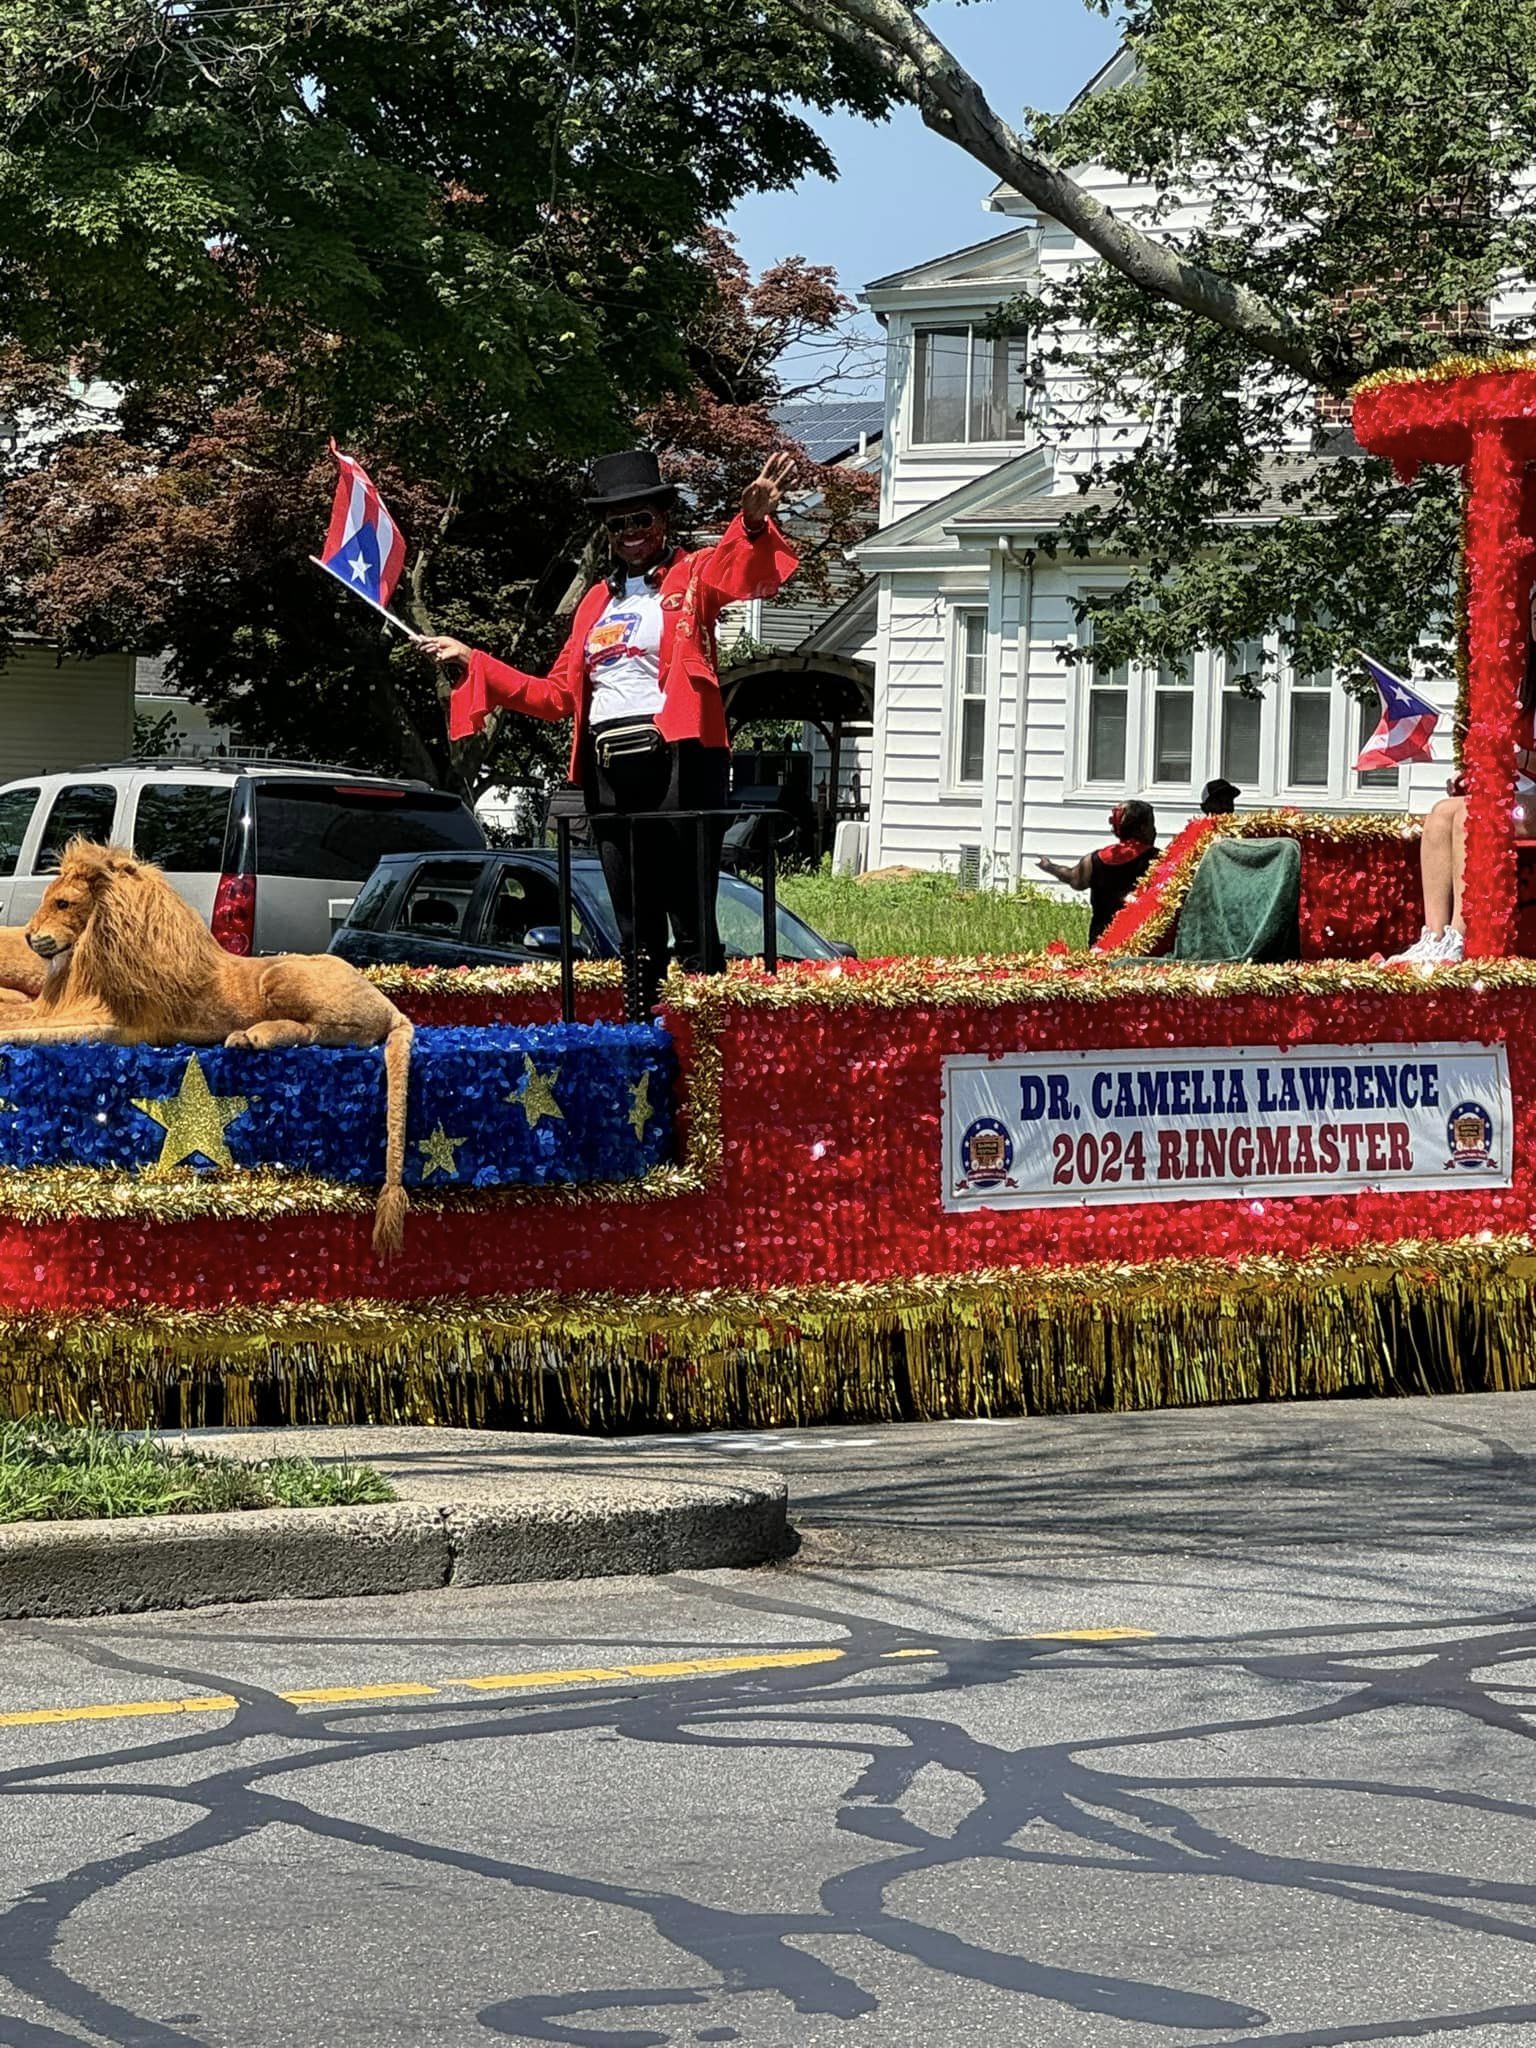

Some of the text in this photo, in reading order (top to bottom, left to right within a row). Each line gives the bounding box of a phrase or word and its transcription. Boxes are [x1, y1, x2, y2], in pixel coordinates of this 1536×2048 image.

[1019, 1064, 1439, 1121] DR. CAMELIA LAWRENCE
[1053, 1122, 1413, 1184] 2024 RINGMASTER
